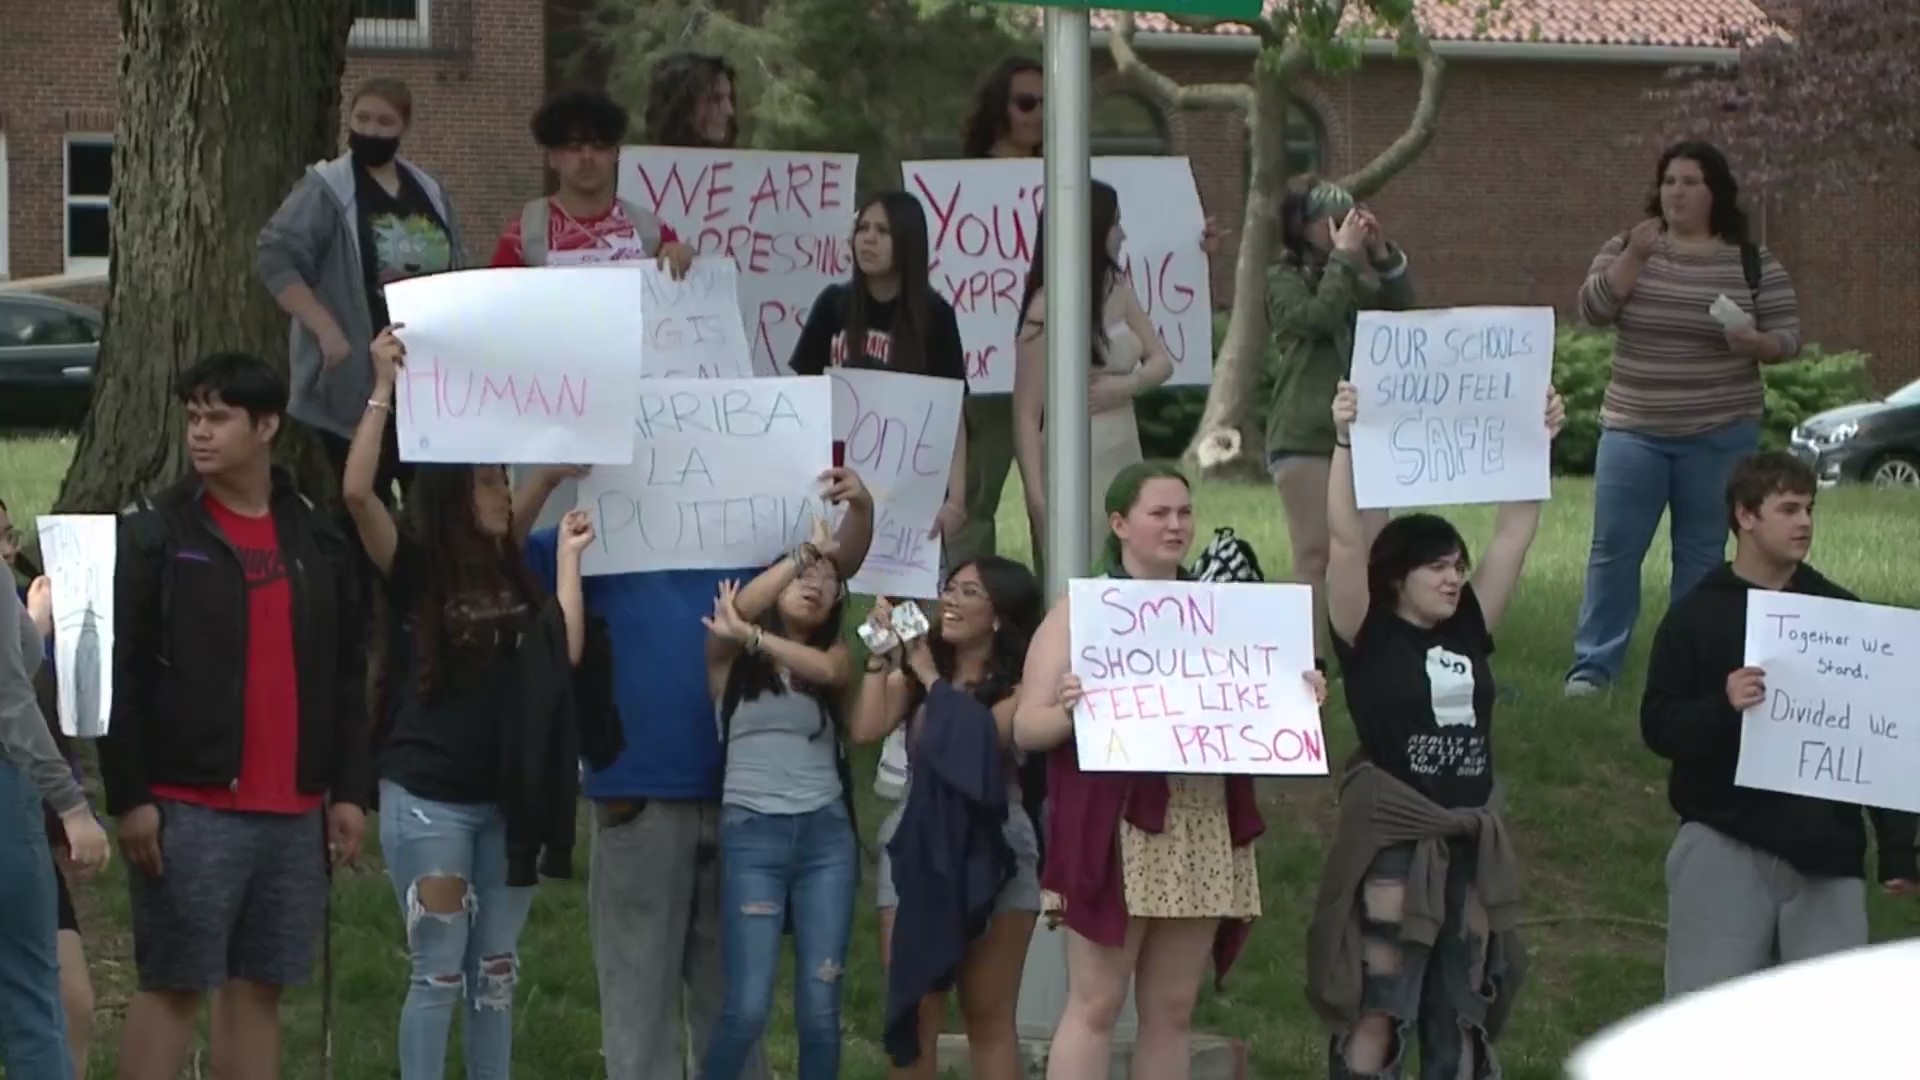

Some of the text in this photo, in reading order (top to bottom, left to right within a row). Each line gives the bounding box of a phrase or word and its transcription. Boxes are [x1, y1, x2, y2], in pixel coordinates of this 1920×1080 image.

[637, 160, 842, 224] WE ARE
[1370, 324, 1534, 370] OUR SCHOOLS
[405, 354, 587, 424] HUMAN
[636, 389, 803, 439] RRIBA
[647, 446, 715, 488] LA
[1389, 408, 1506, 486] SAFE
[1766, 613, 1849, 653] Together
[1080, 683, 1271, 721] FEEL LIKE
[1770, 688, 1851, 730] Divided
[1106, 724, 1322, 765] A PRISON
[1797, 740, 1872, 785] FALL
